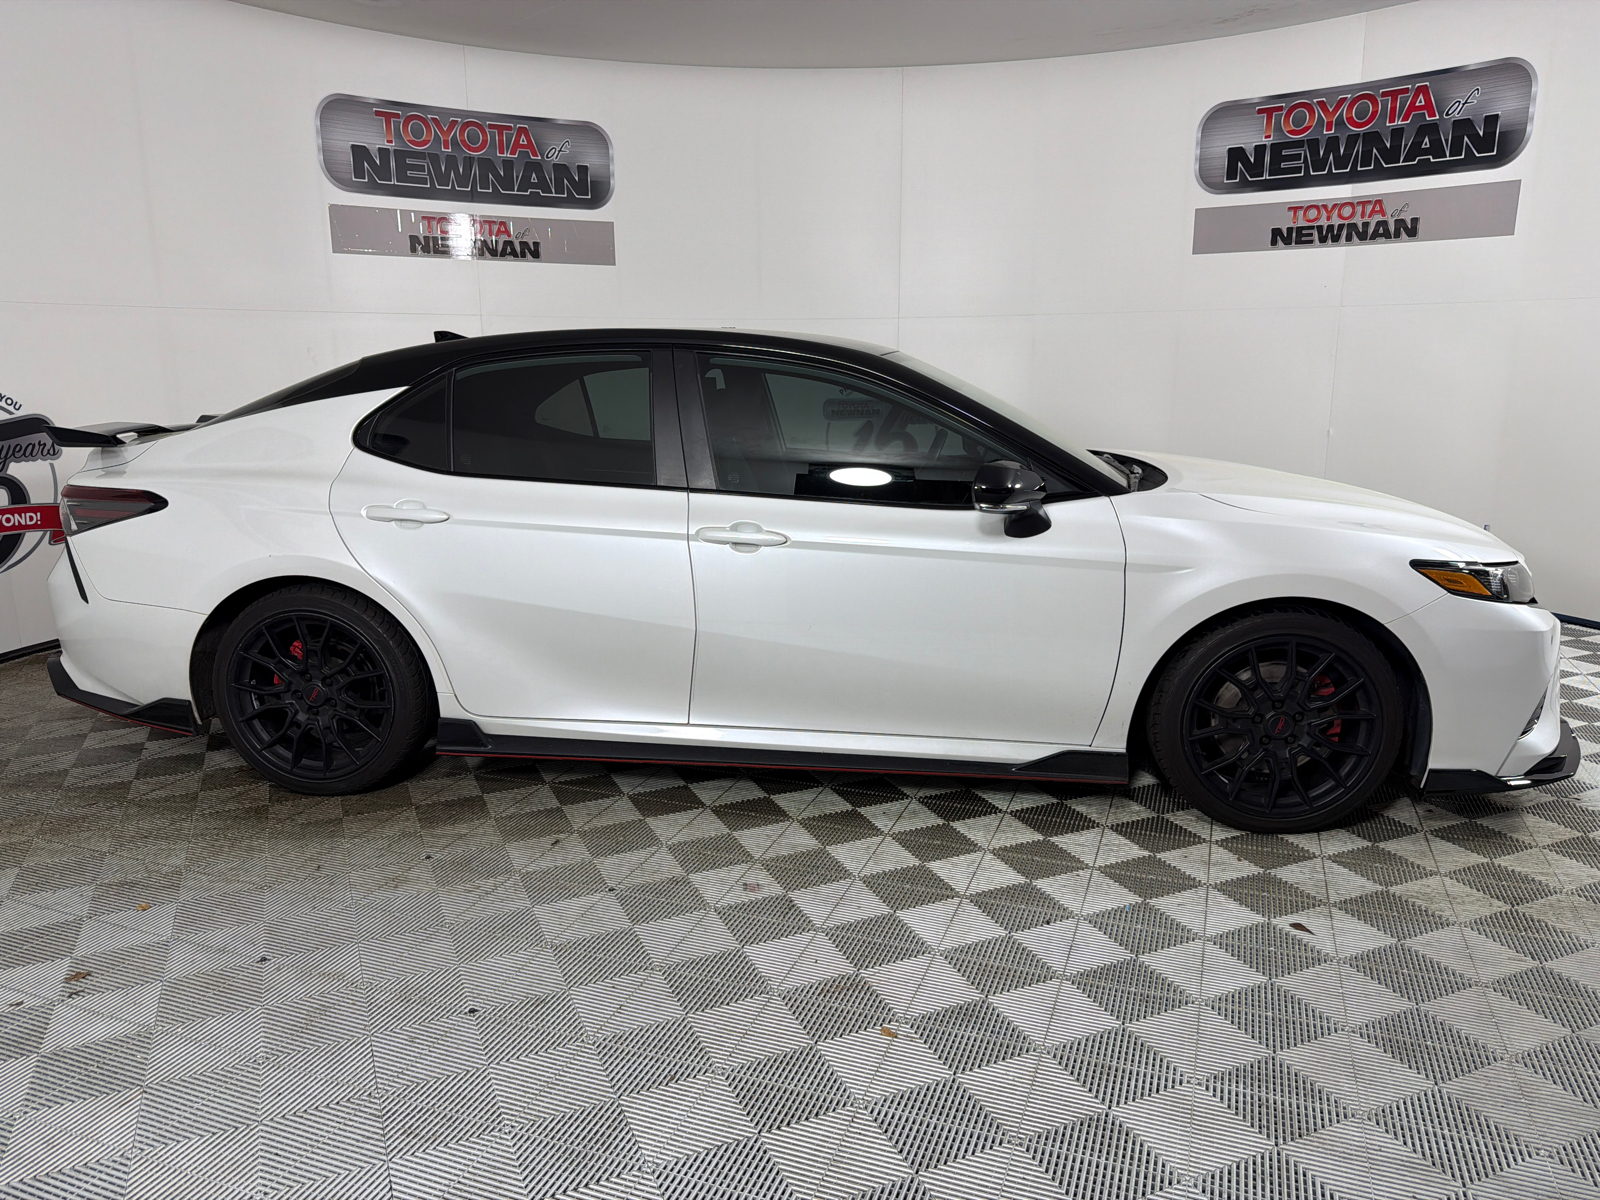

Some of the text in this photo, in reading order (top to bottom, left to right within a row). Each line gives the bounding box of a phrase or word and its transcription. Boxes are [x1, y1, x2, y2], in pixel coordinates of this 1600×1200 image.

[1256, 82, 1481, 140] TOYOTA of
[373, 108, 571, 161] TOYOTA of
[1224, 112, 1501, 183] NEWNAN
[350, 143, 592, 198] NEWNAN
[1287, 199, 1409, 225] TOYOTA of
[421, 215, 530, 241] TOOTA of
[1270, 217, 1420, 248] NEWNAN
[408, 234, 541, 259] NENAN
[838, 402, 870, 410] TOYOTA
[0, 440, 59, 472] years
[0, 512, 41, 527] OND!
